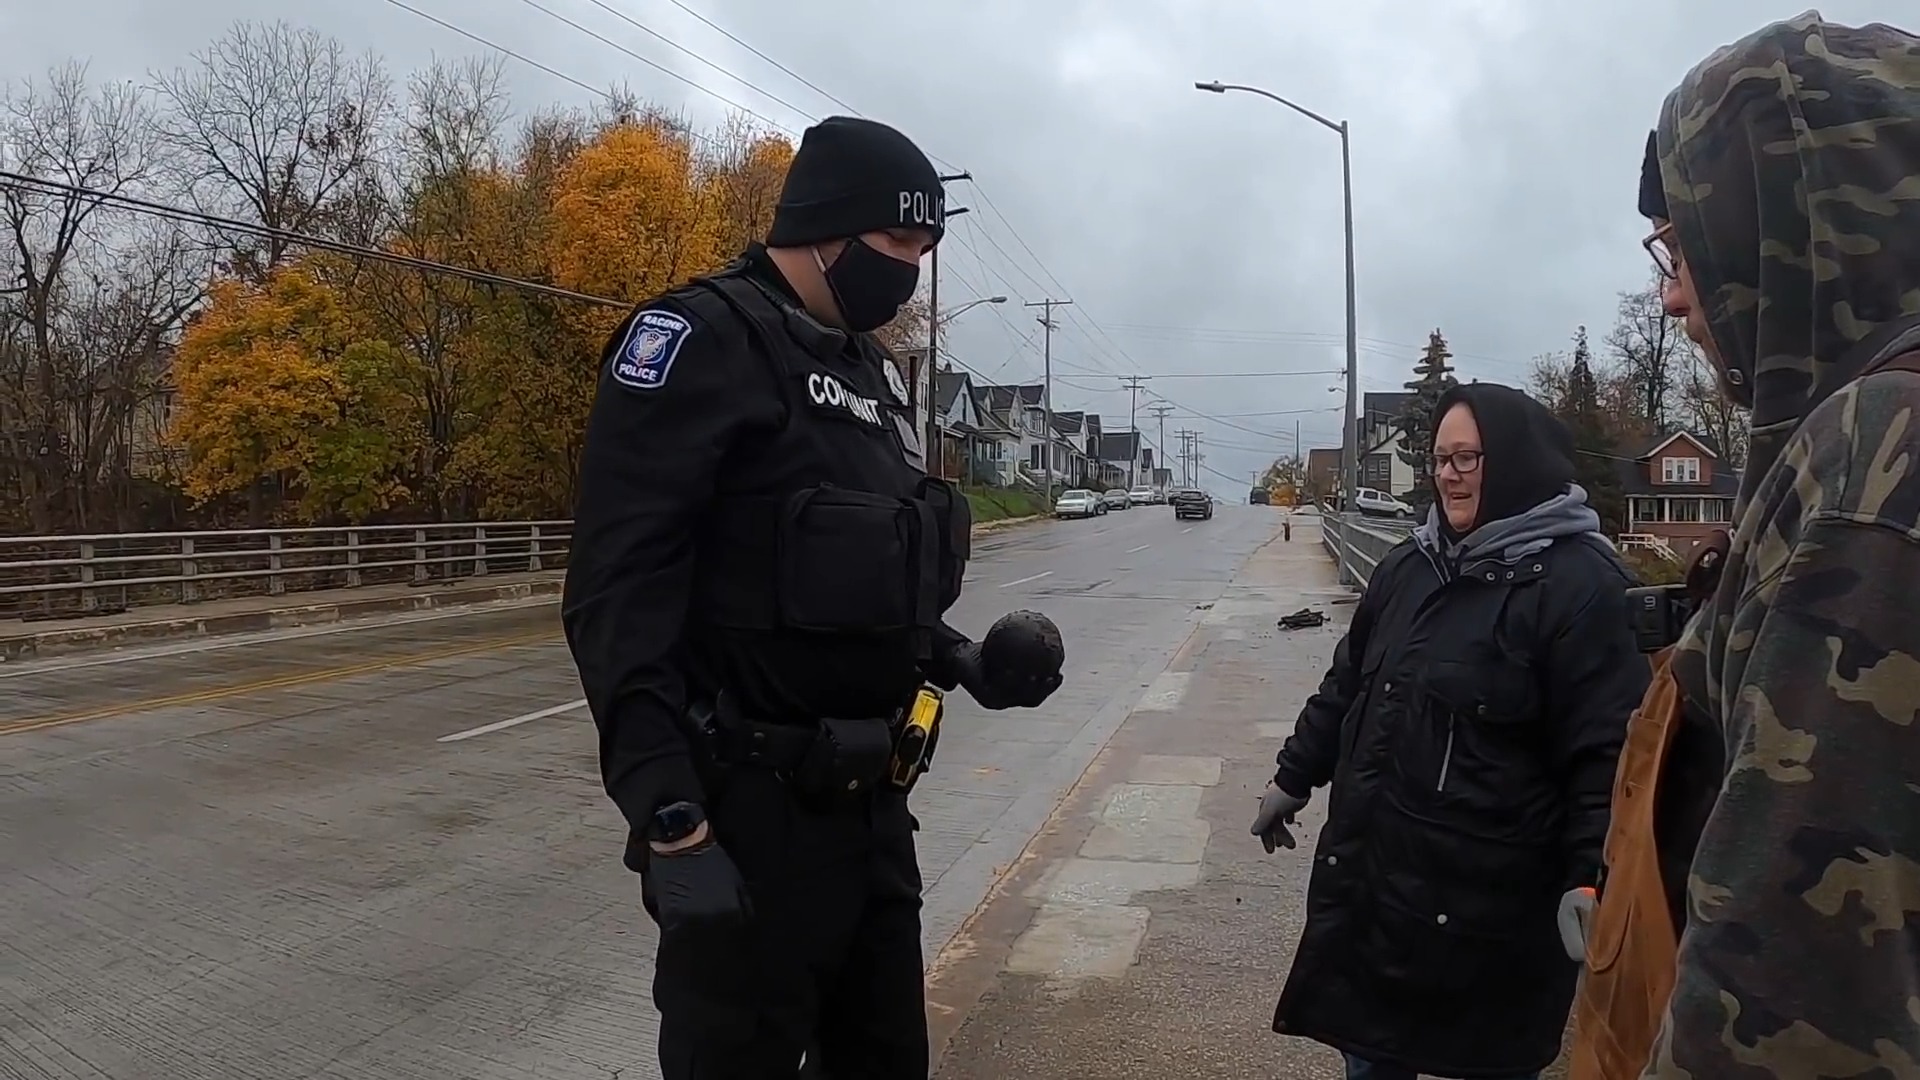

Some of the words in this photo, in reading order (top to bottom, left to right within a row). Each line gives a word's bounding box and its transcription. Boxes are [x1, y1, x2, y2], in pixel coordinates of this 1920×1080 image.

[642, 315, 685, 332] RACINE
[618, 363, 659, 382] POLICE
[1644, 596, 1656, 608] 9
